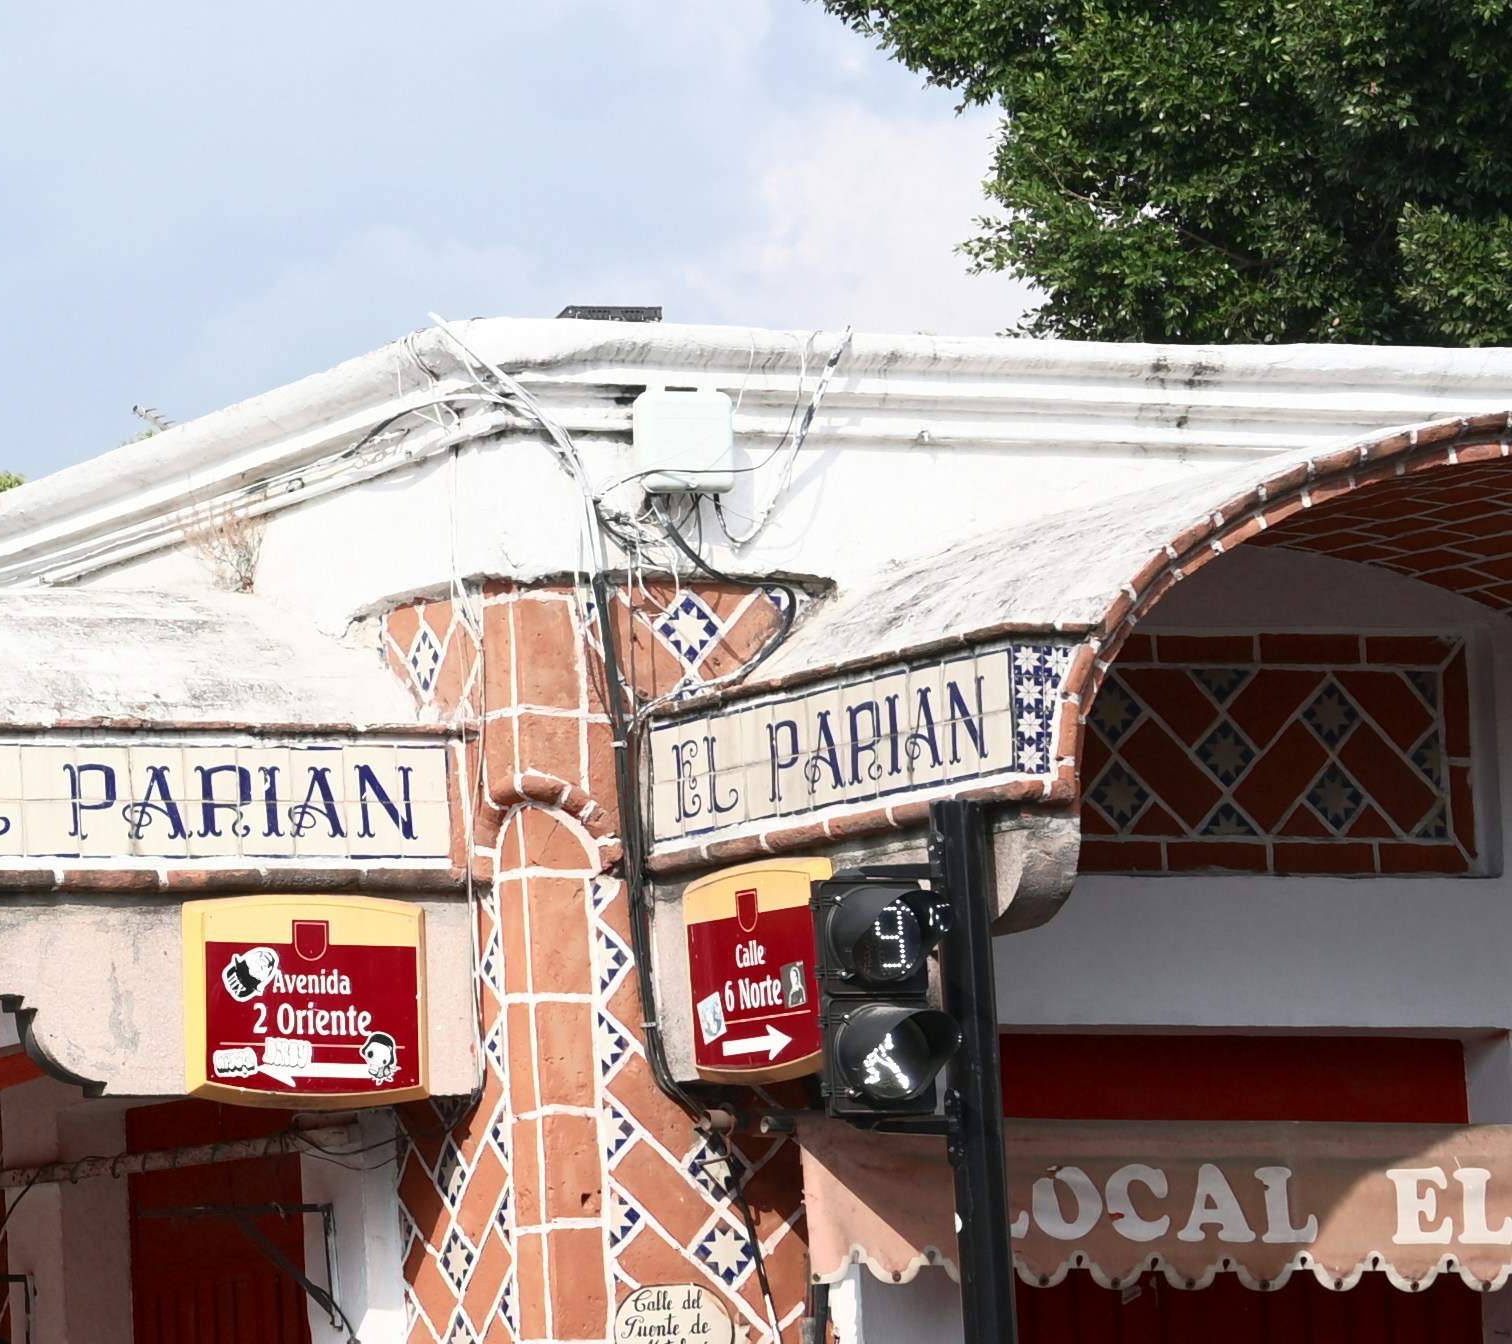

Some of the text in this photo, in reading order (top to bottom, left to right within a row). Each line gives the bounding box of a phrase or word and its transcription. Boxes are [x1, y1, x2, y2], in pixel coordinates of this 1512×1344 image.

[671, 675, 989, 824] EL PARIAN
[63, 763, 418, 841] PARIAN
[735, 939, 767, 968] Calle
[272, 968, 352, 995] Avenida
[724, 976, 783, 1012] 6 Norte
[252, 1001, 372, 1036] 2 Oriente
[1011, 1163, 1319, 1244] OCAL
[632, 1289, 703, 1312] Calle del
[621, 1313, 712, 1339] Puente de
